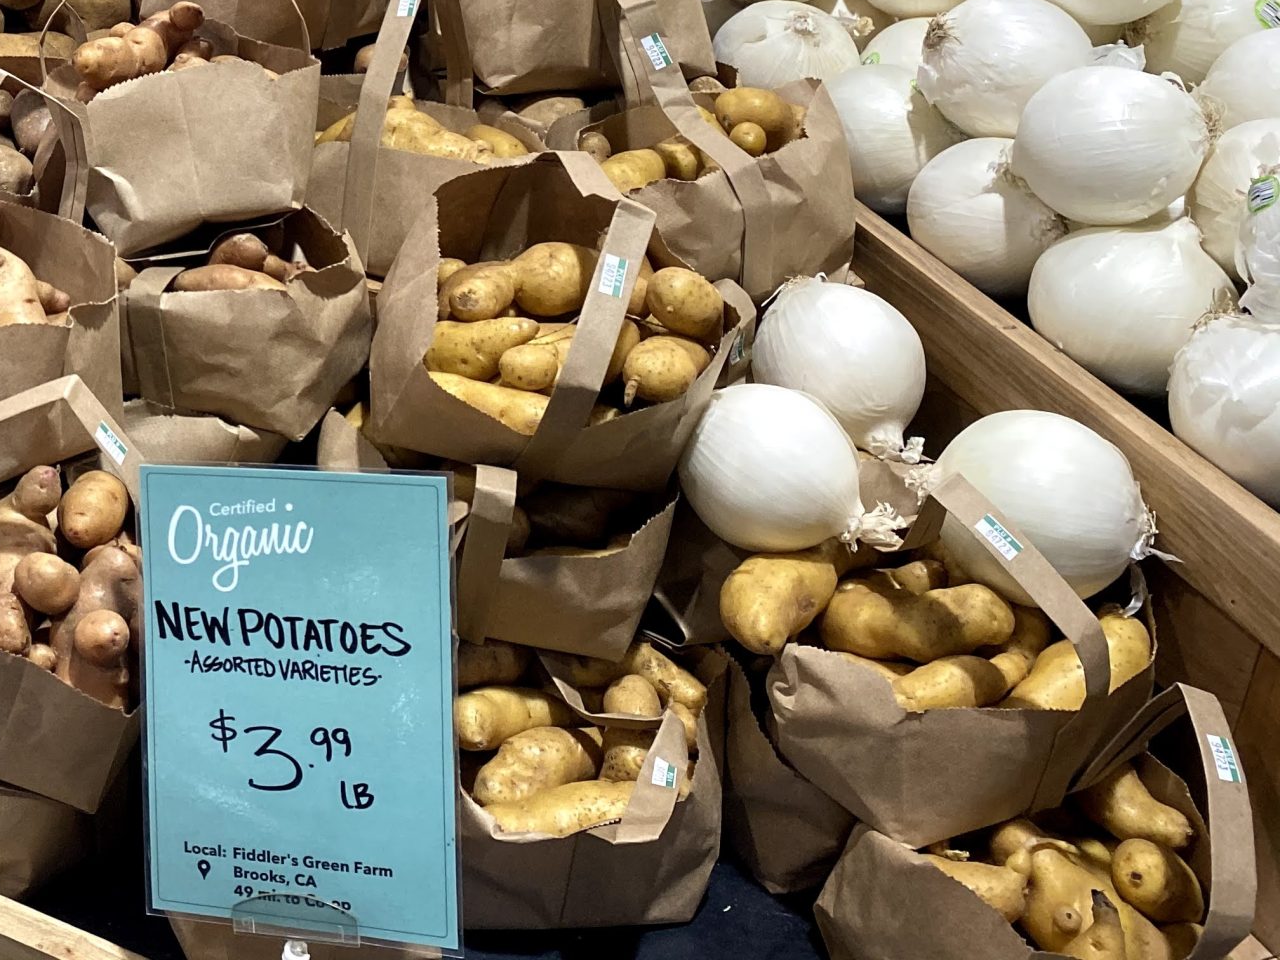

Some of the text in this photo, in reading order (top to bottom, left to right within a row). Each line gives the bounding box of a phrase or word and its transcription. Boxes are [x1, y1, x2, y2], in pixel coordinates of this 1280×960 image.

[646, 45, 664, 67] 94723
[654, 40, 664, 52] PLU
[208, 498, 276, 517] Certified
[168, 502, 313, 592] Organic
[154, 599, 412, 657] NEW POTATOES
[1212, 741, 1228, 771] 94723
[340, 781, 374, 810] LB
[184, 841, 393, 878] Local: Fiddler's Green Farm
[233, 866, 318, 888] Brooks, CA
[234, 884, 254, 898] 49
[258, 889, 281, 903] mi.
[285, 894, 300, 905] to
